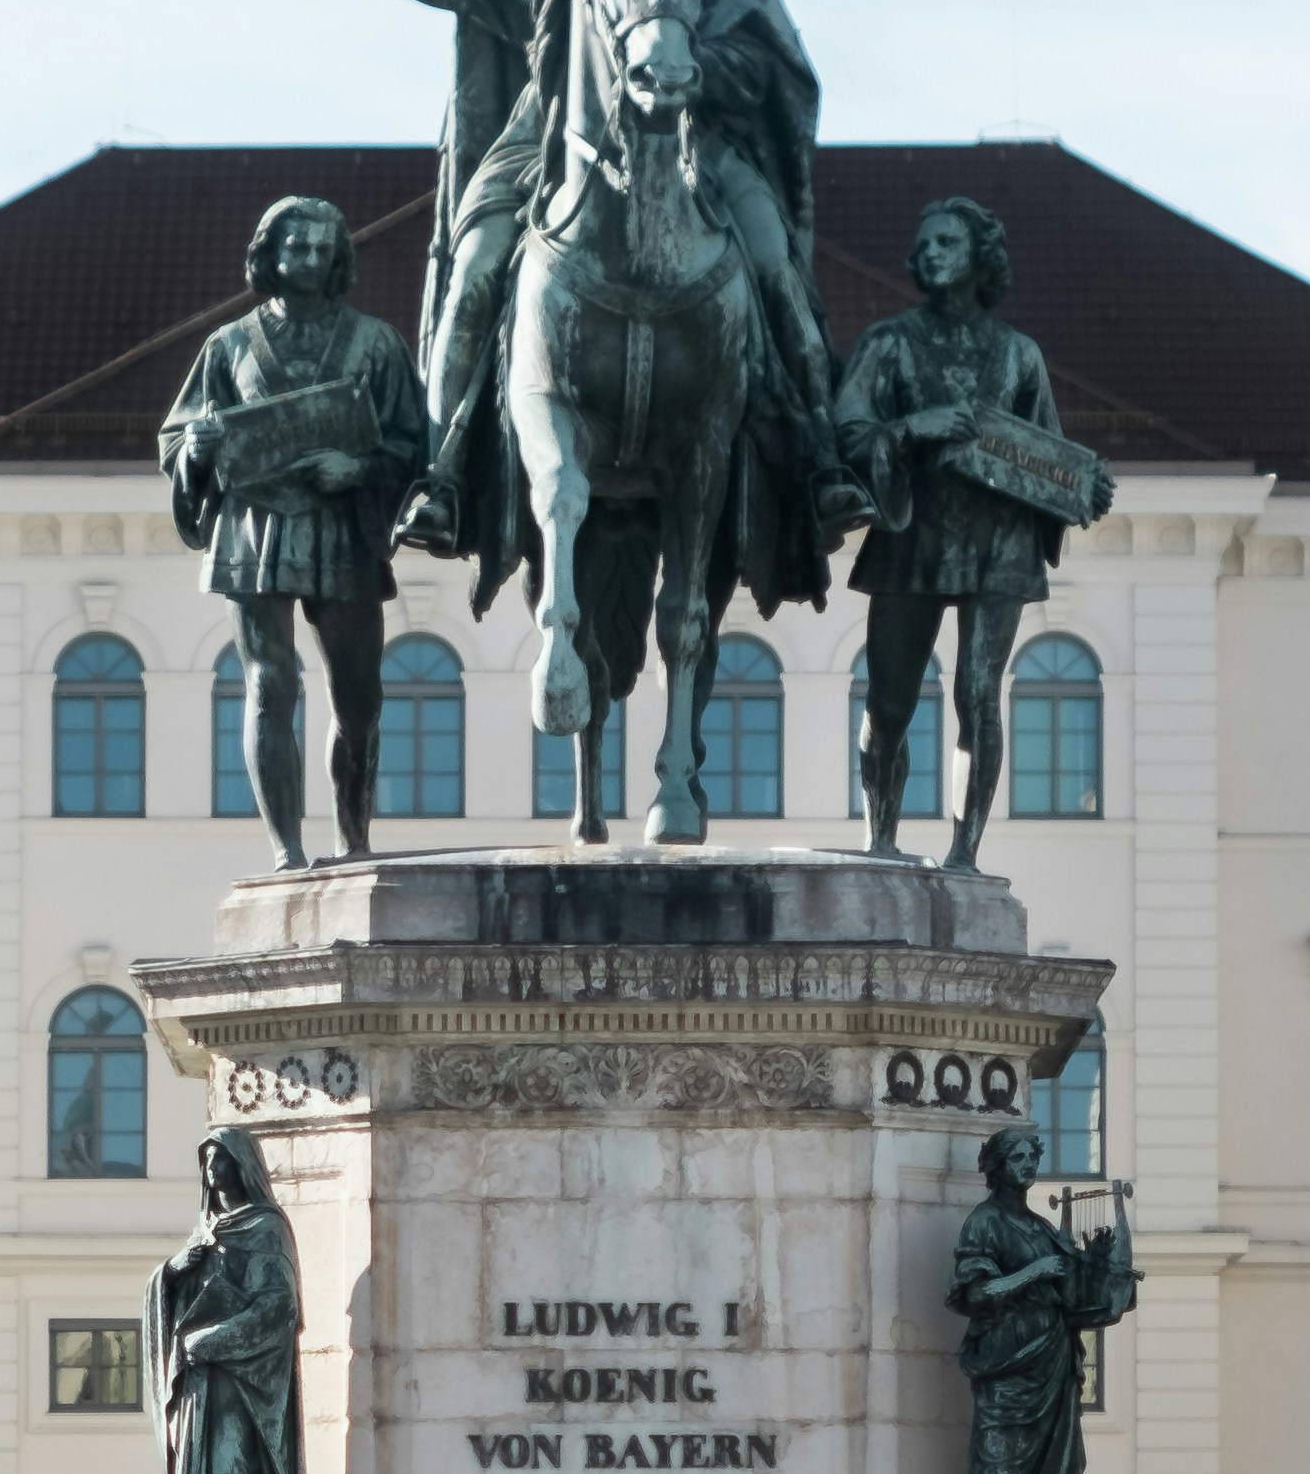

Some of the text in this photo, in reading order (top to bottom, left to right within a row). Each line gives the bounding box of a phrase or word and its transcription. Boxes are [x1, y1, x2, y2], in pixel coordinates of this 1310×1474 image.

[502, 1301, 740, 1337] LUDWIG I
[524, 1367, 716, 1404] KOENIG
[467, 1433, 778, 1469] VON BAYERN
